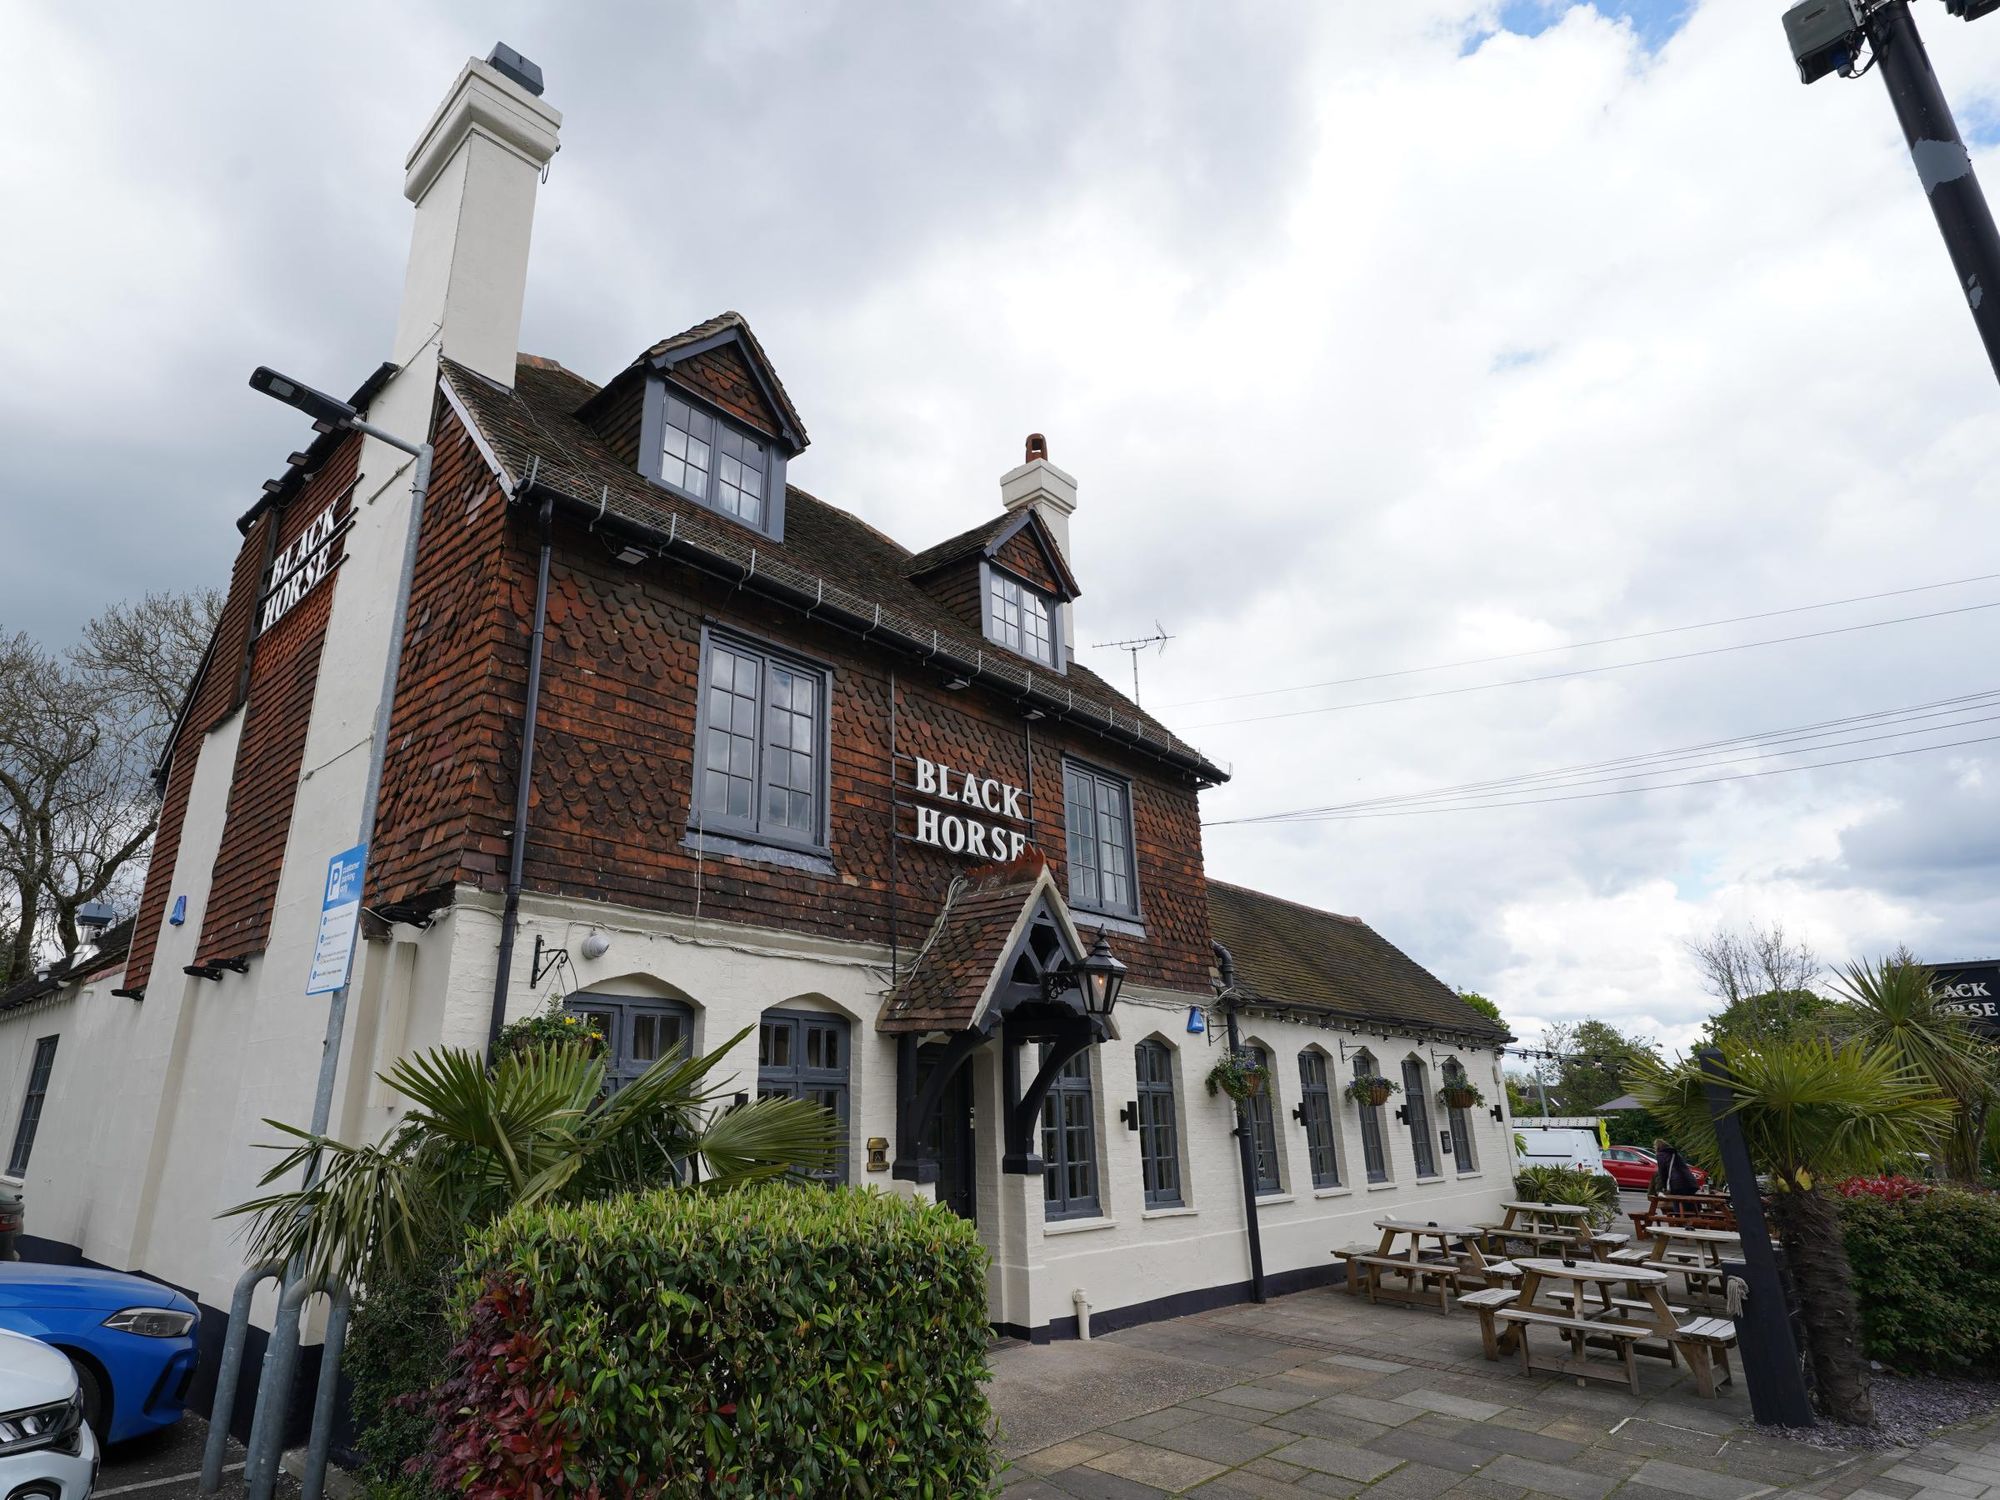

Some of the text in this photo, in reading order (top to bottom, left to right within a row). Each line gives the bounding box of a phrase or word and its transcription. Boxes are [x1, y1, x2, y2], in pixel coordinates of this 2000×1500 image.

[269, 497, 339, 592] BLACK
[257, 541, 331, 637] HORSE
[916, 756, 1025, 821] BLACK
[916, 805, 1026, 863] HORSE
